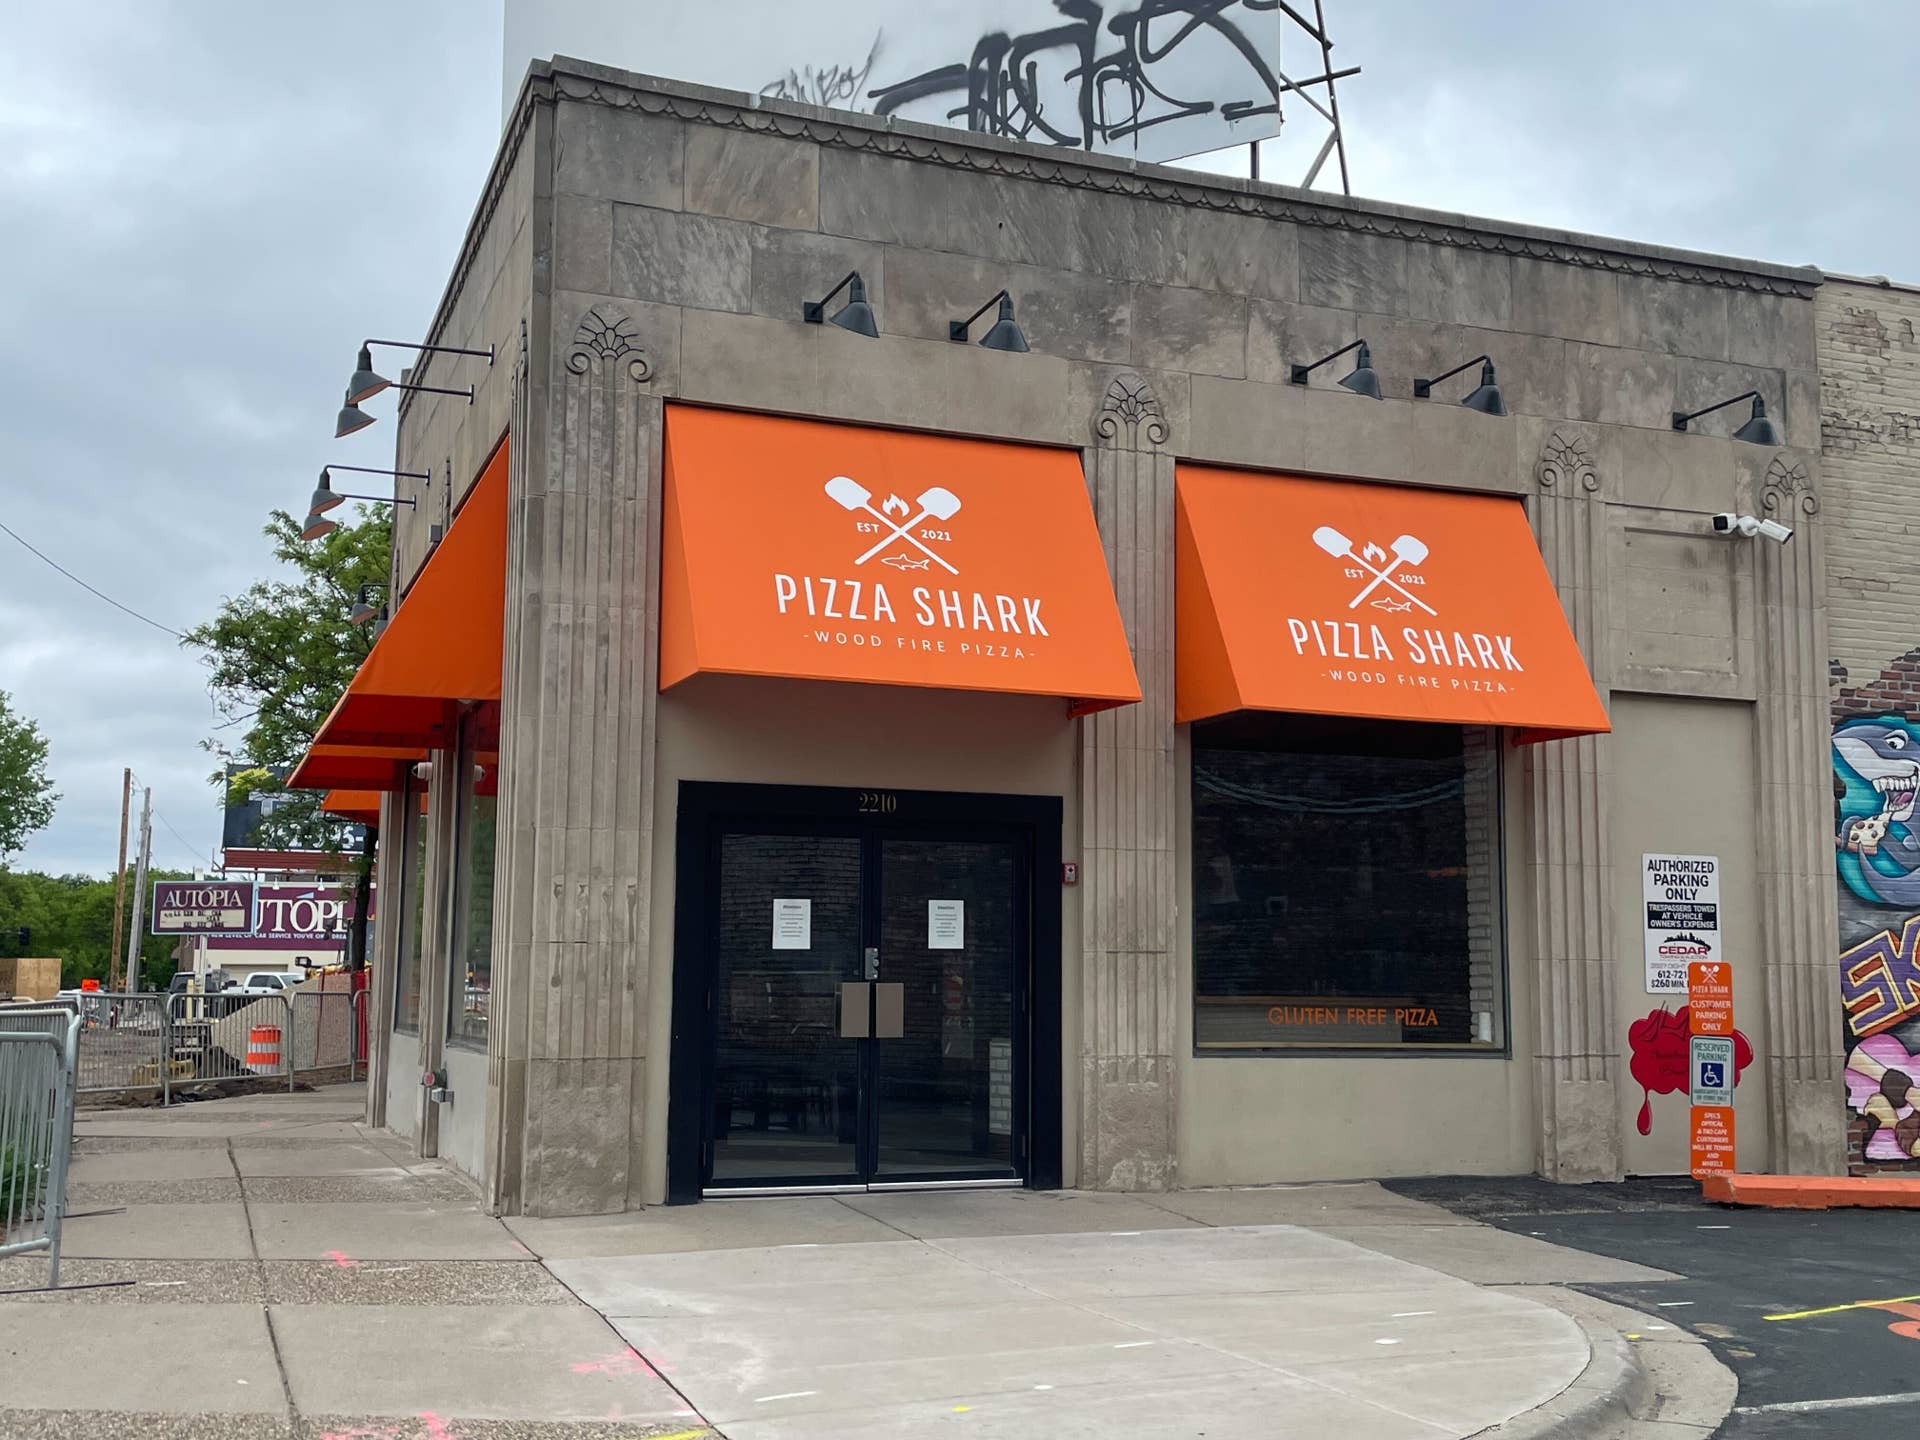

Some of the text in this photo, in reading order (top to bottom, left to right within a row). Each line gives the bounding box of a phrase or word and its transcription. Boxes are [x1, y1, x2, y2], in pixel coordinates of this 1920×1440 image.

[857, 521, 880, 534] EST
[920, 529, 952, 542] 2021
[1344, 568, 1364, 580] EST
[774, 573, 1049, 637] PIZZA SHARK
[897, 637, 946, 653] FIRE
[1287, 618, 1524, 672] PIZZA SHARK
[1397, 674, 1440, 689] FIRE
[858, 792, 897, 813] 2210
[1647, 859, 1715, 874] AUTHORIZED
[1653, 873, 1709, 888] PARKING
[1665, 887, 1698, 901] ONLY
[1648, 903, 1716, 913] TRESPASSERS TOWED
[1661, 911, 1703, 921] AT VEHICLE
[1650, 919, 1716, 929] OWNER'S EXPENSE
[1658, 945, 1708, 955] CEDAR
[1692, 985, 1729, 994] PIZZA SHARK
[1690, 999, 1731, 1009] CUSTOMER
[1268, 1006, 1439, 1026] GLUTEN FREE PIZZA
[1695, 1010, 1727, 1020] PARKING
[1701, 1022, 1722, 1031] ONLY
[1694, 1041, 1730, 1053] RESERVED
[1697, 1051, 1728, 1062] PARKING
[1706, 1152, 1720, 1160] AND
